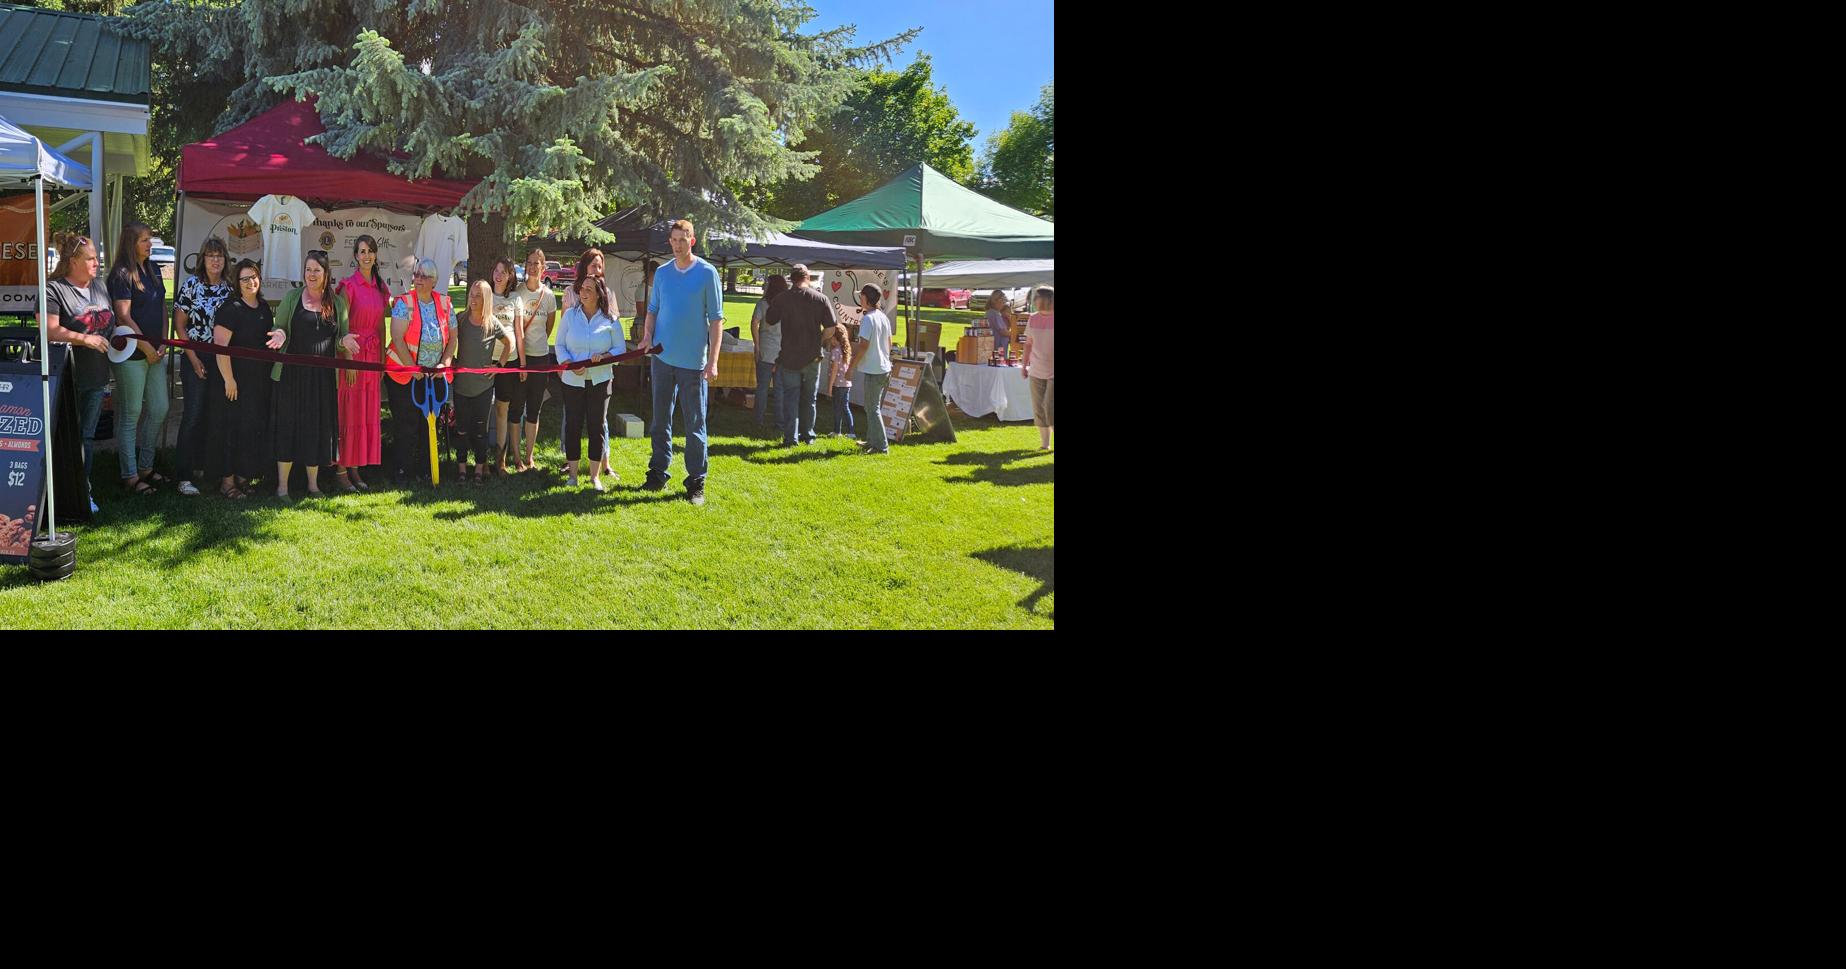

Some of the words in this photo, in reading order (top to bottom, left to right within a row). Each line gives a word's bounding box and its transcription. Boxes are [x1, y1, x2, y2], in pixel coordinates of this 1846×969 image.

[0, 243, 38, 260] ESE
[259, 281, 289, 289] ARKET
[833, 296, 861, 325] COUNTR
[0, 415, 43, 435] ZED
[8, 470, 26, 487] $12
